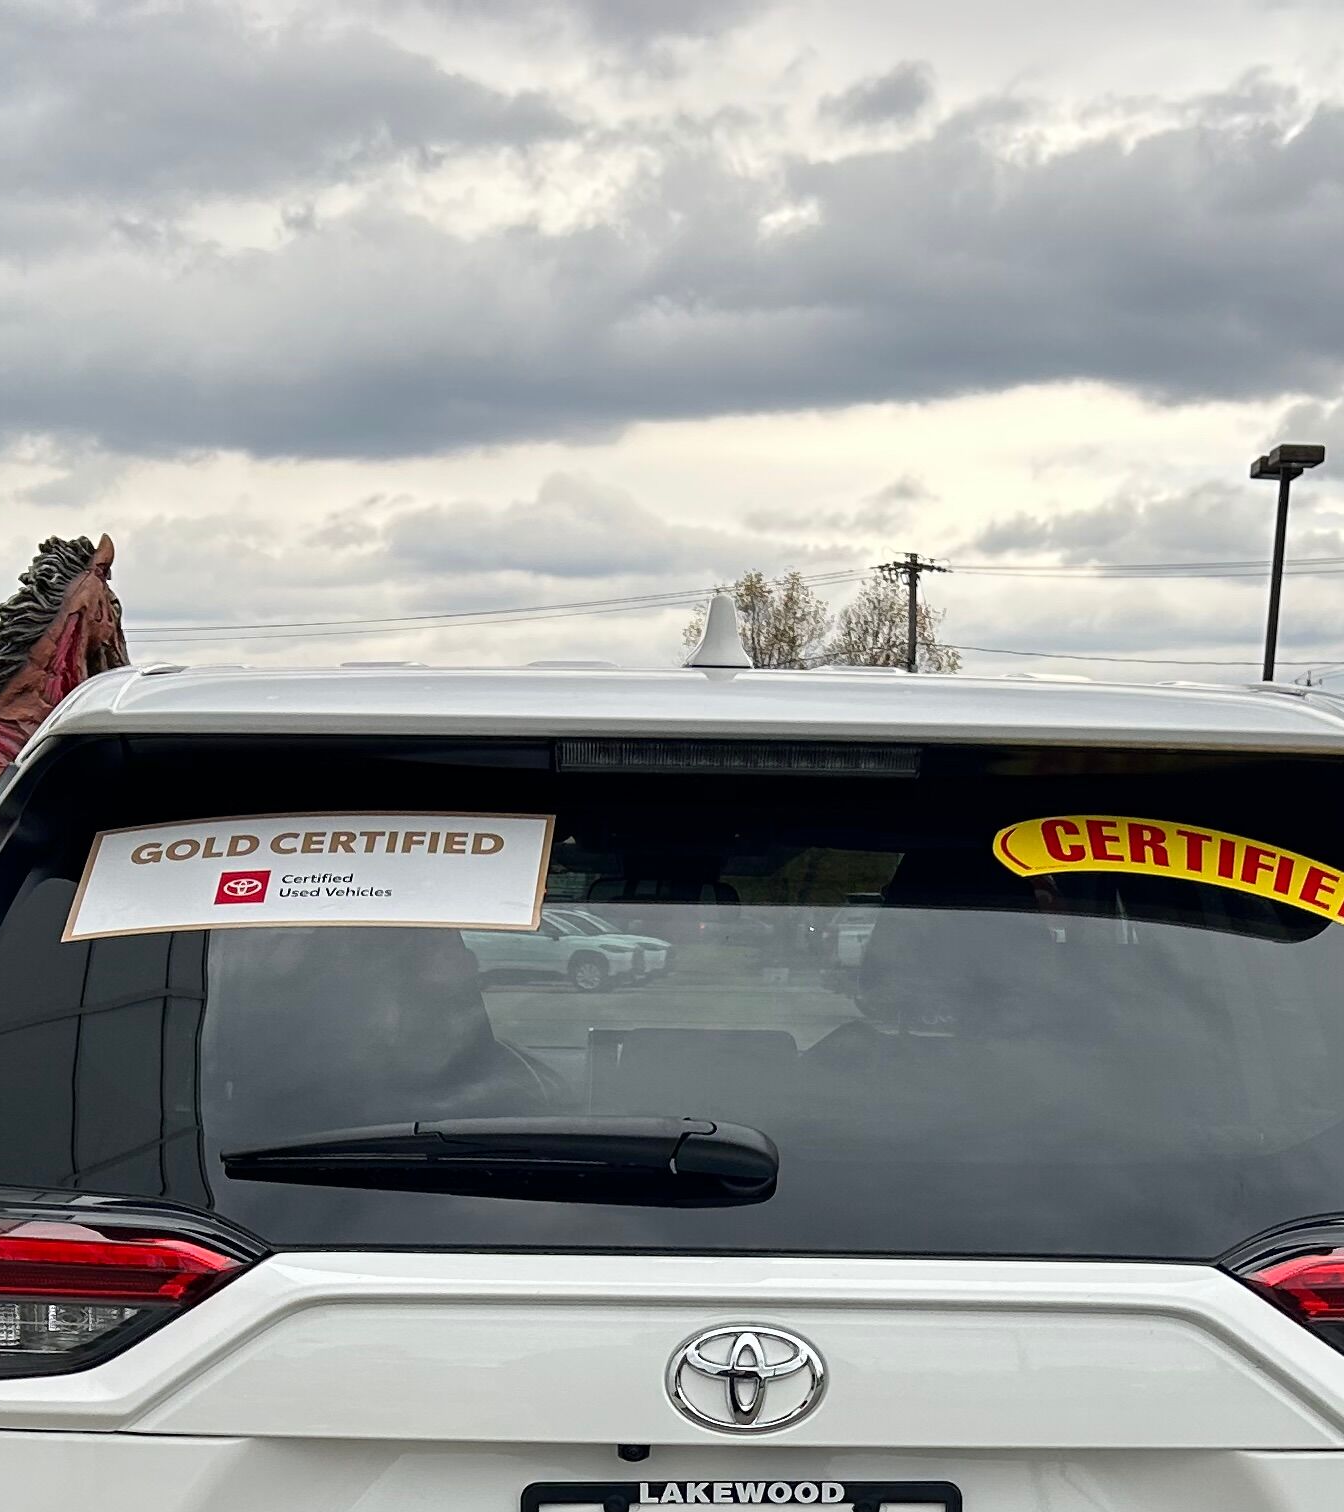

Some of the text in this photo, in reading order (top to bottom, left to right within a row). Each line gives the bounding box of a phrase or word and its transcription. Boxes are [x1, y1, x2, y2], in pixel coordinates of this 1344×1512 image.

[130, 830, 506, 865] GOLD CERTIFIED
[281, 873, 354, 884] Certified
[279, 887, 393, 898] Used Vehicles
[640, 1482, 845, 1503] LAKEWOOD
